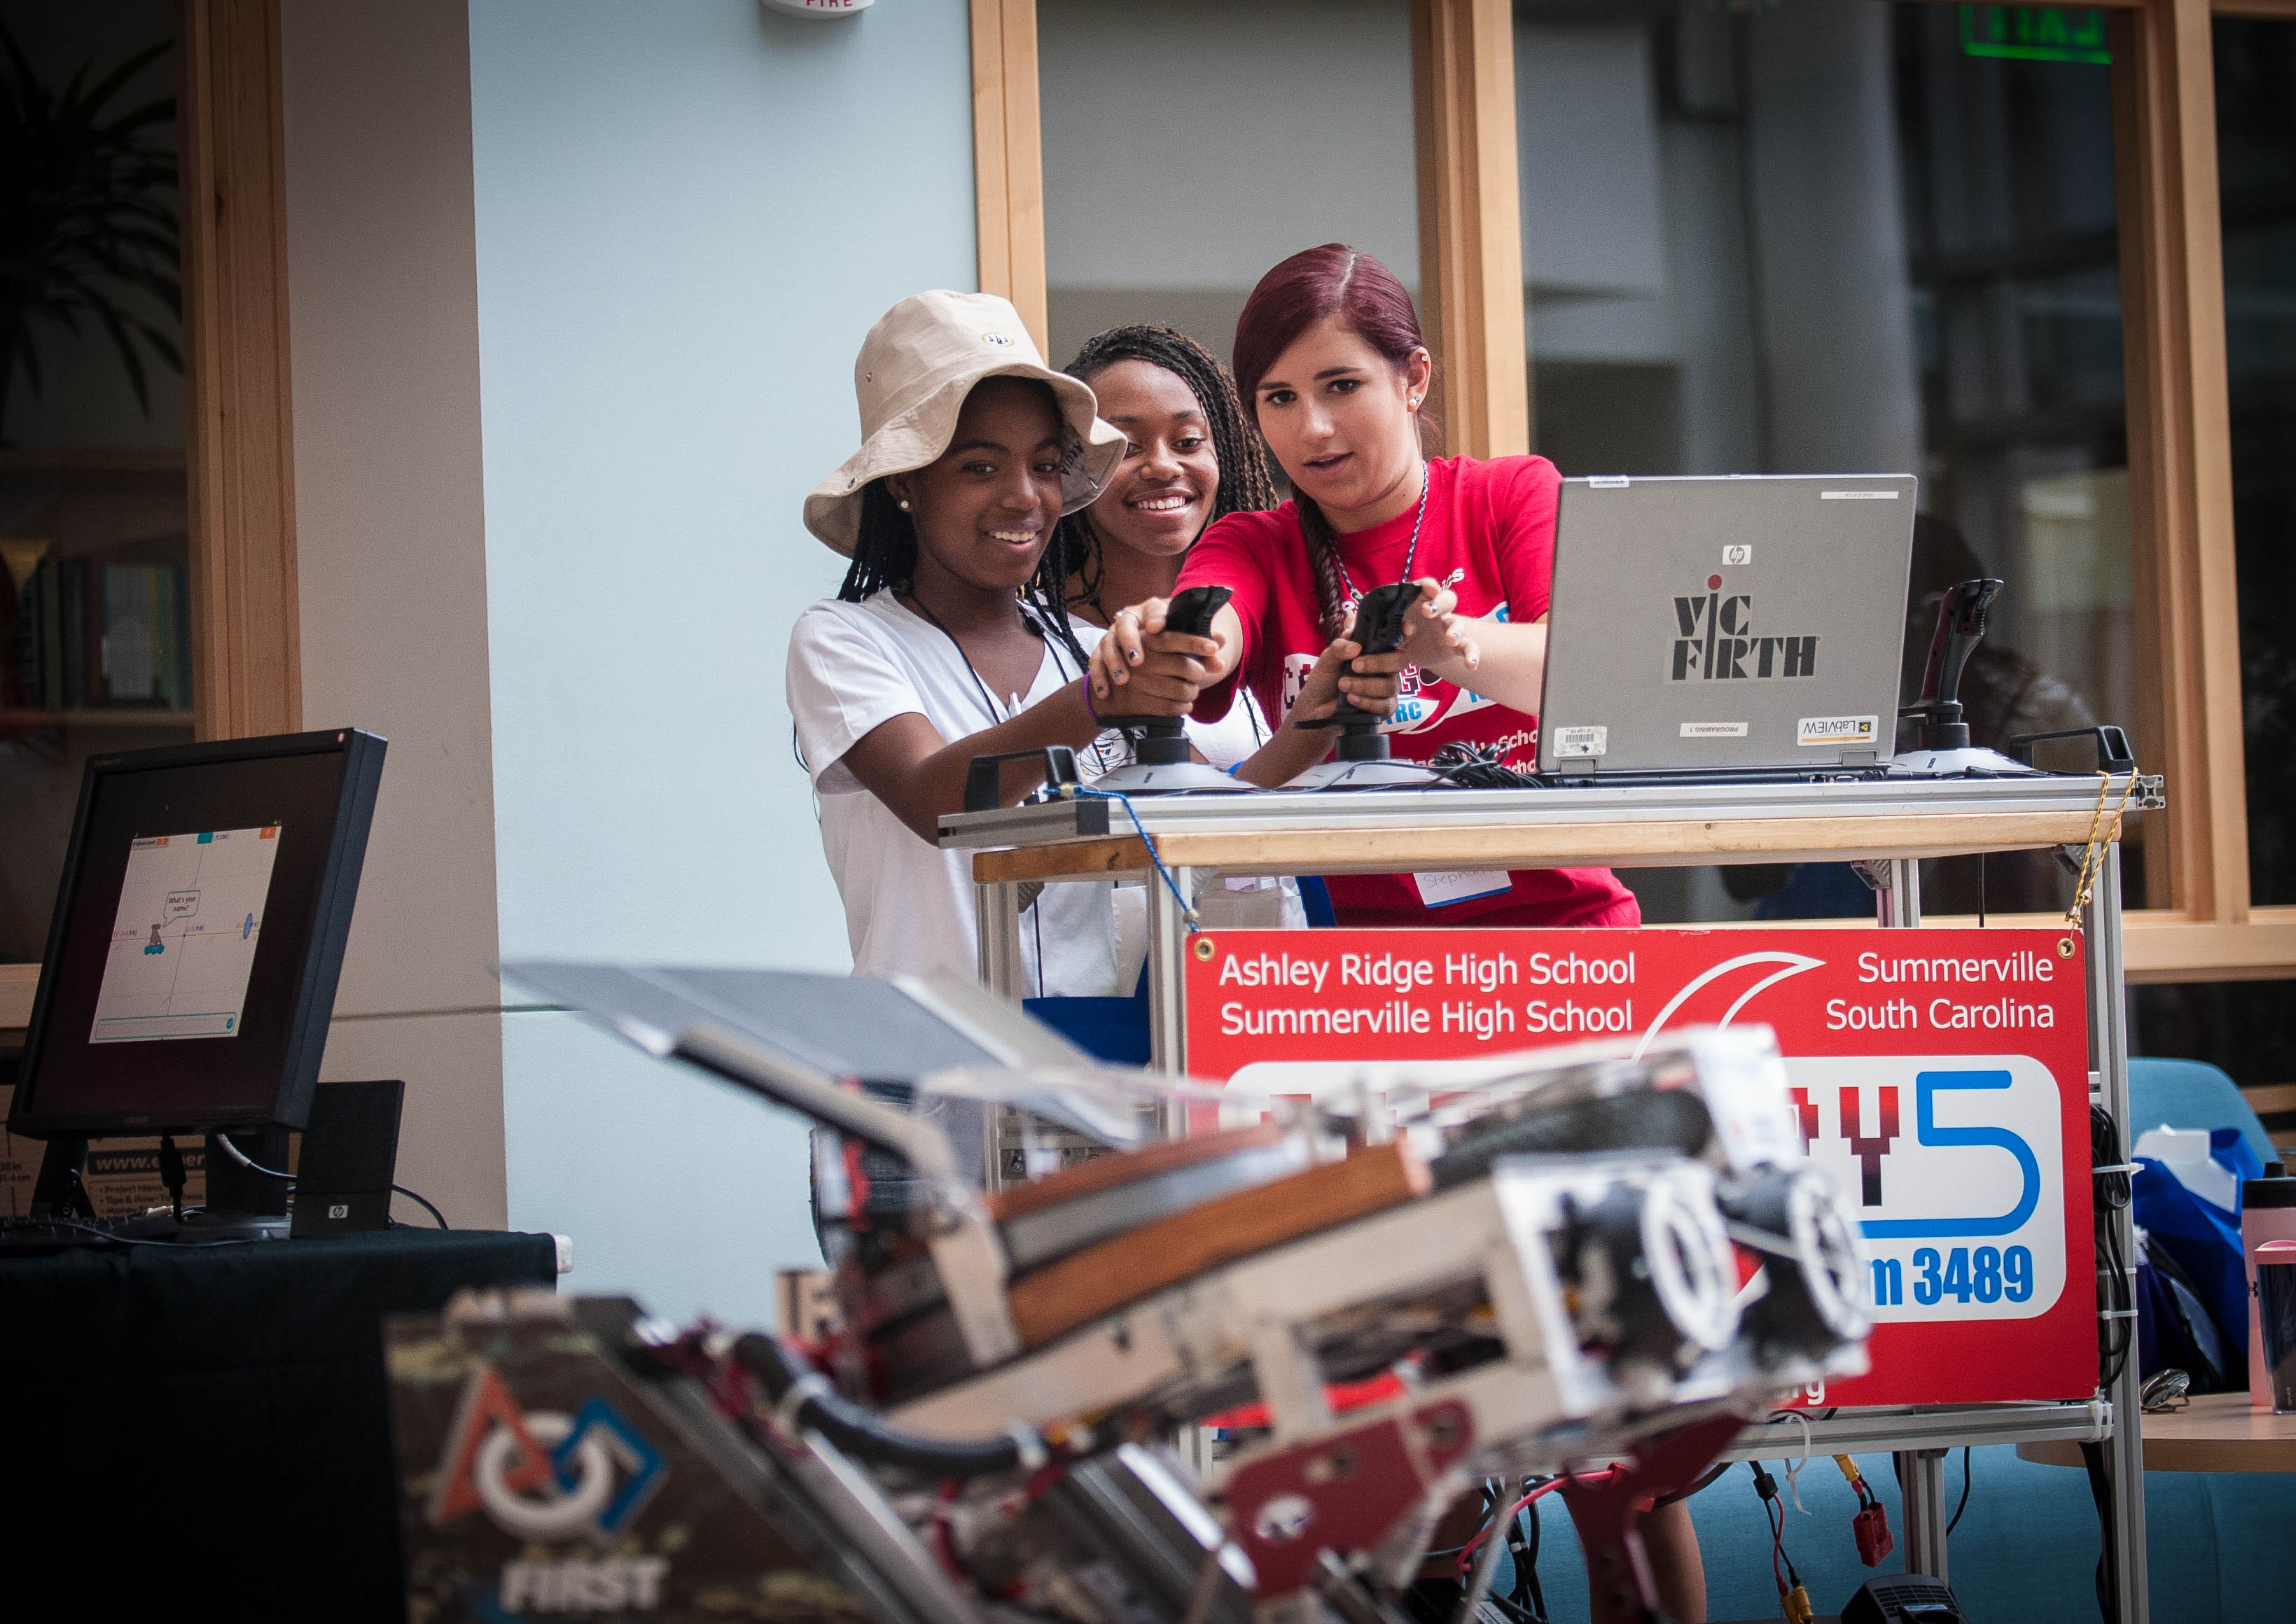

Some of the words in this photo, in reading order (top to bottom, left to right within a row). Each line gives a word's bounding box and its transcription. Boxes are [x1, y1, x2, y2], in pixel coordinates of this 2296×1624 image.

[1498, 729, 1538, 753] Scho
[1803, 720, 1856, 734] LabVIEW
[185, 895, 197, 904] your
[1219, 953, 1329, 993] Ashley
[1341, 953, 1433, 993] Ridge
[1445, 953, 1518, 993] High
[1530, 951, 1635, 985] School
[1858, 951, 2053, 983] Summerville
[1221, 1002, 1430, 1035] Summerville
[1442, 1001, 1515, 1041] High
[1526, 1000, 1632, 1033] School
[1826, 998, 1917, 1030] South
[1928, 997, 2054, 1029] Carolina
[1912, 1245, 2033, 1306] 3489
[499, 1556, 669, 1615] FIRST
